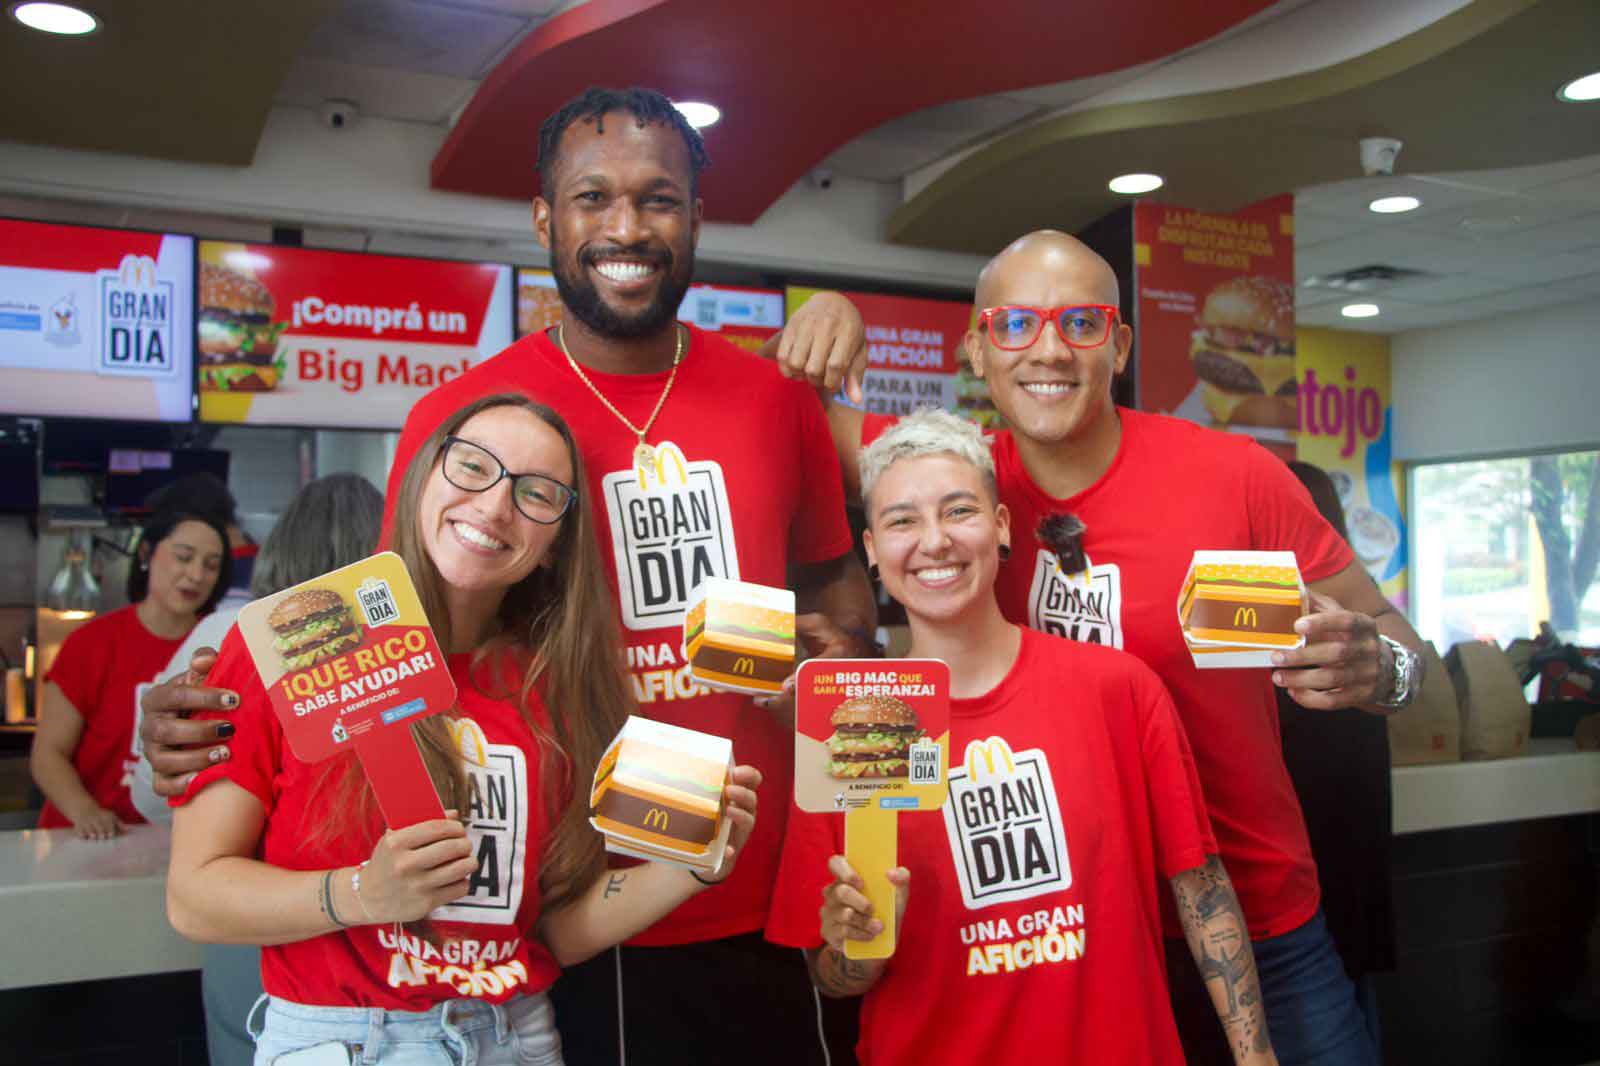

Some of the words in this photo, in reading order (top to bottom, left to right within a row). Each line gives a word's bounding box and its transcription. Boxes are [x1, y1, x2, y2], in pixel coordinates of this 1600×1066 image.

[109, 291, 167, 321] GRAN
[292, 297, 424, 335] ¡Comprá
[428, 311, 467, 333] un
[865, 326, 897, 342] UNA
[900, 329, 943, 345] GRAN
[298, 348, 364, 394] Big
[867, 344, 944, 369] AFICIÓN
[866, 377, 912, 395] PARA
[917, 380, 942, 397] UN
[628, 489, 712, 542] GRAN
[362, 587, 388, 605] GRAN
[1047, 576, 1104, 620] GRAN
[281, 656, 353, 701] ¡QUE
[354, 629, 427, 674] RICO
[293, 688, 339, 717] SABE
[340, 651, 436, 702] AYUDAR!
[835, 671, 861, 685] BIG
[863, 671, 898, 684] MAC
[898, 673, 922, 684] QUE
[346, 692, 387, 712] BENEFICIO
[845, 684, 936, 698] ESPERANZA!
[914, 751, 936, 762] GRAN
[467, 772, 507, 821] AN
[960, 777, 1040, 829] GRAN
[970, 822, 1051, 888] DÍA
[960, 918, 1015, 945] UNA
[1017, 903, 1085, 935] GRAN
[377, 928, 442, 961] UNA
[443, 937, 520, 965] GRAN
[967, 926, 1086, 976] AFICIÓN
